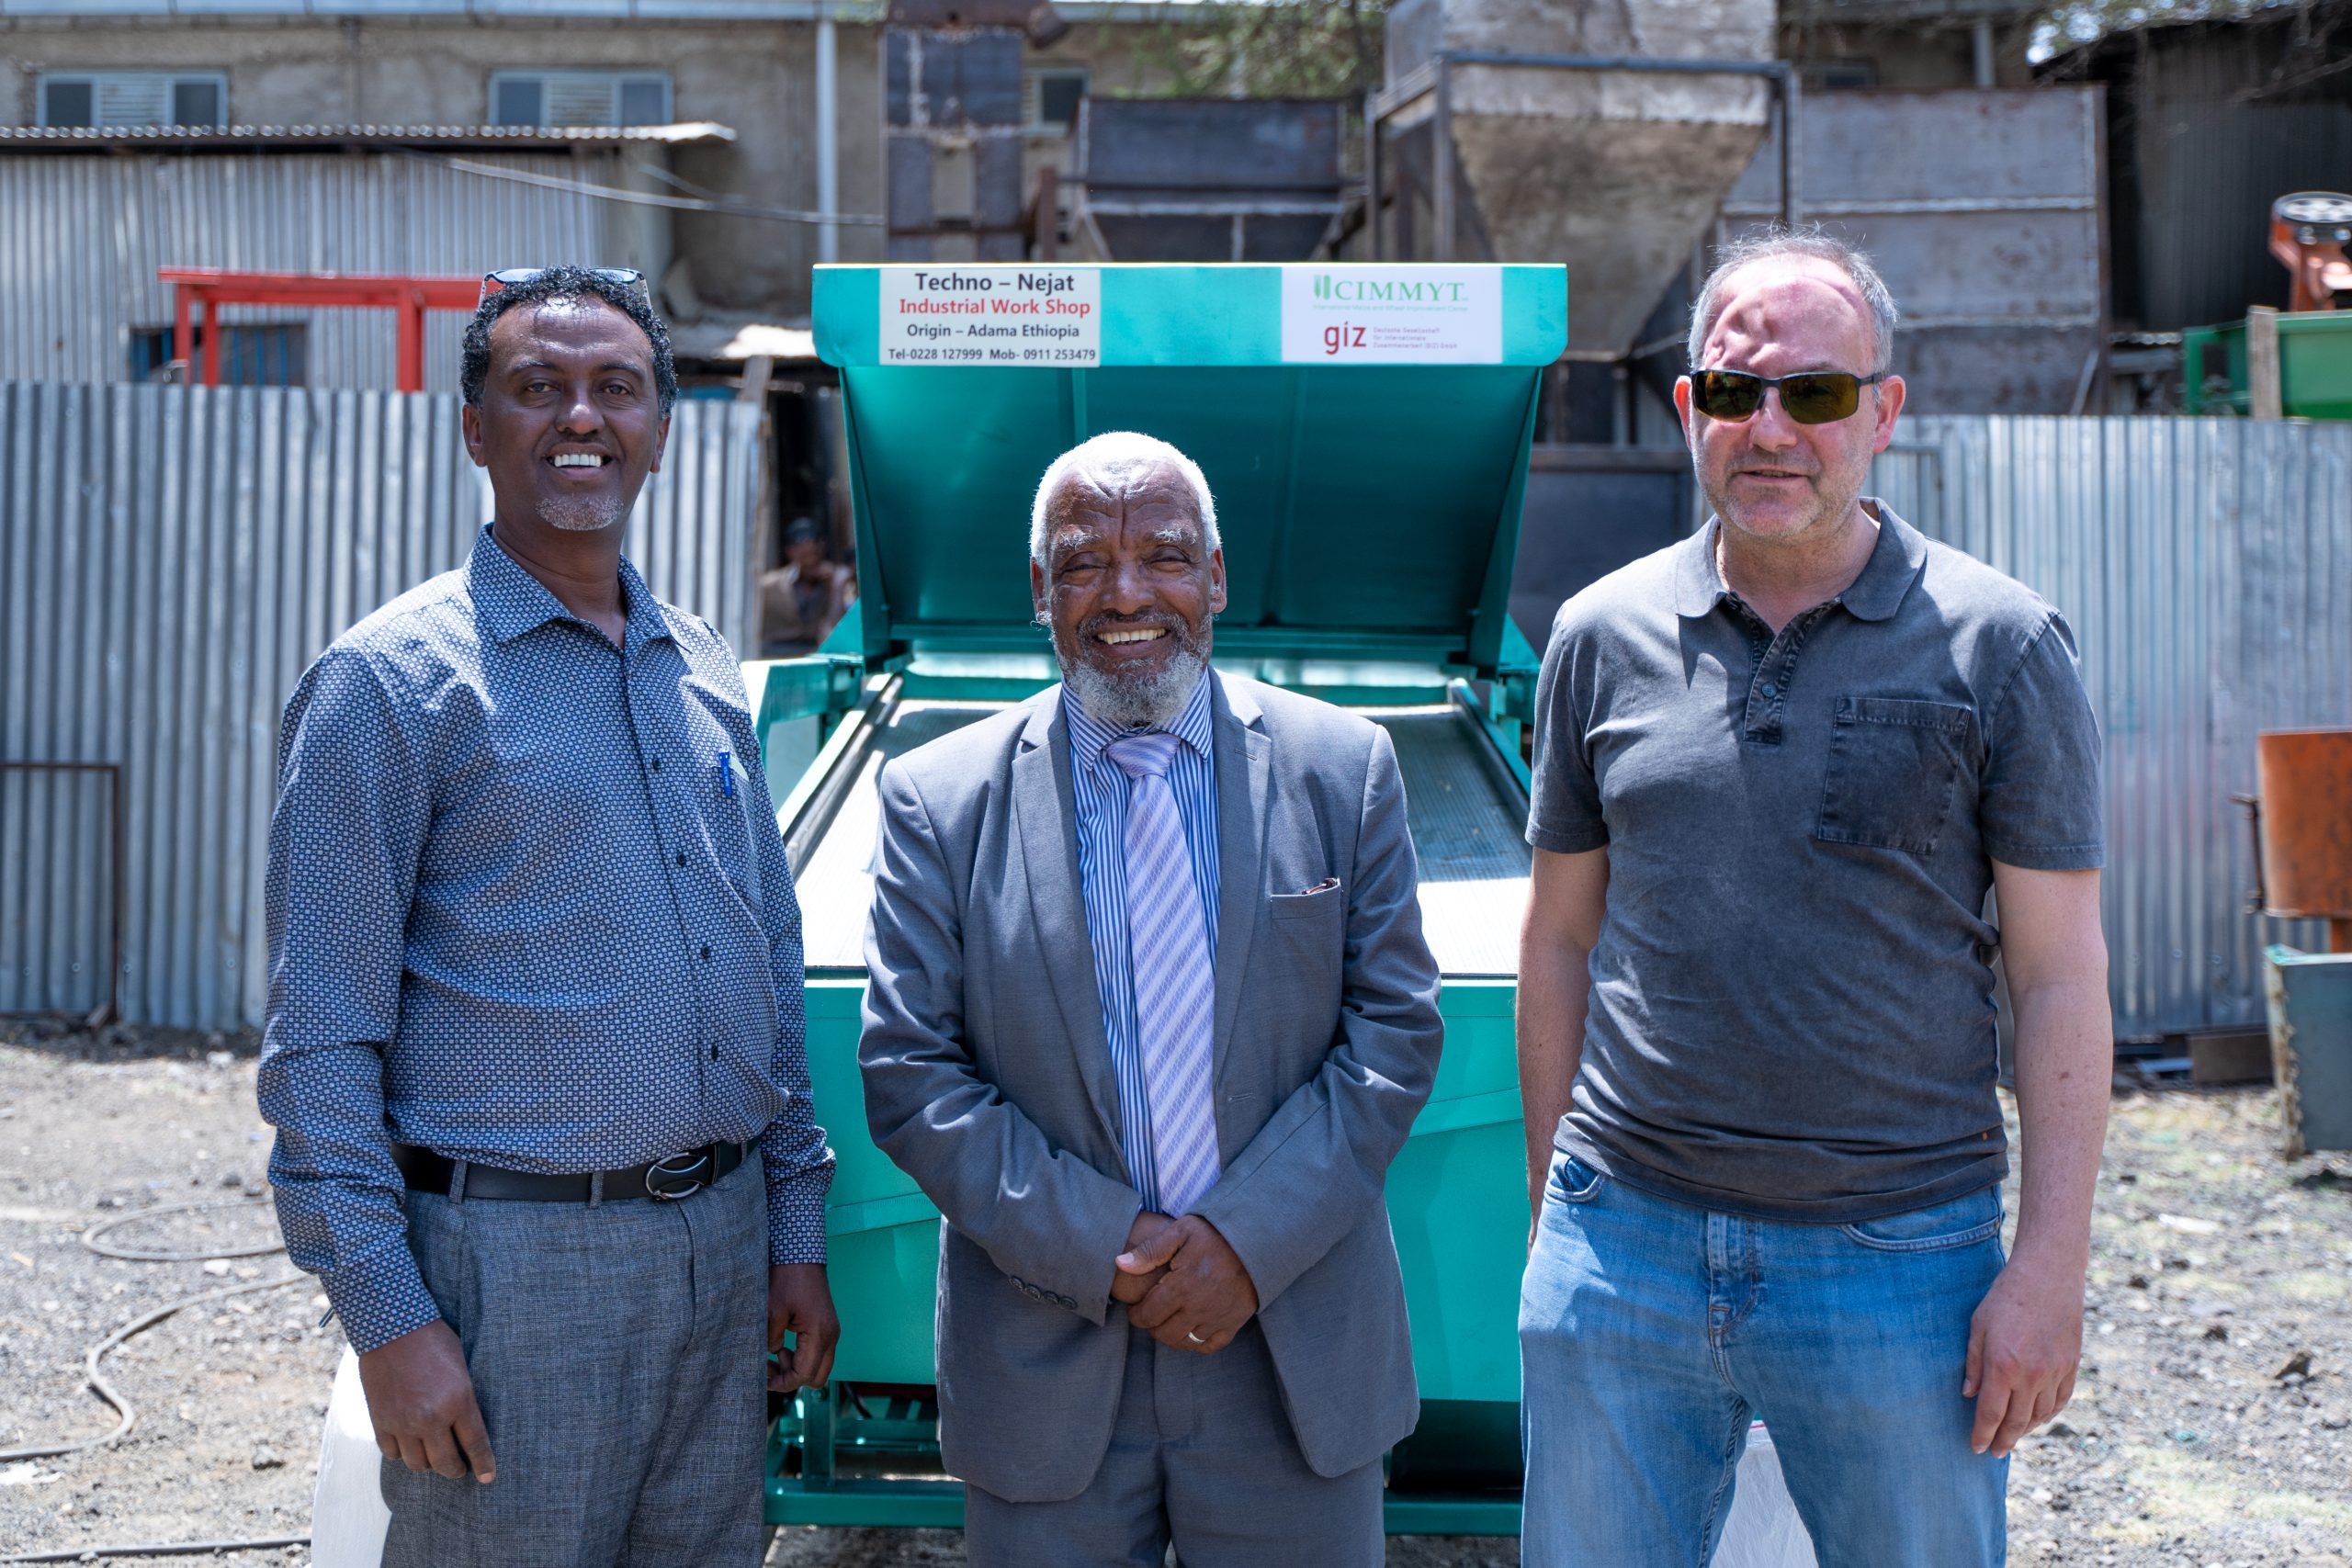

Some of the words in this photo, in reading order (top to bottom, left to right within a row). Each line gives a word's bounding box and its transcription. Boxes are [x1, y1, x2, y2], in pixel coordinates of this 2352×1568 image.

[915, 272, 992, 290] Techno
[1018, 273, 1074, 296] Nejat
[1335, 281, 1464, 301] CIMMYT
[900, 299, 984, 313] Industrial
[991, 299, 1039, 313] Work
[1046, 299, 1090, 318] Shop
[907, 324, 951, 340] Origin
[967, 324, 1017, 336] Adama
[1023, 324, 1079, 340] Ethiopia
[1325, 321, 1367, 355] giz
[943, 349, 982, 359] 127999
[990, 349, 1020, 359] Mob-
[1023, 349, 1049, 359] 0911
[1055, 349, 1095, 360] 253479
